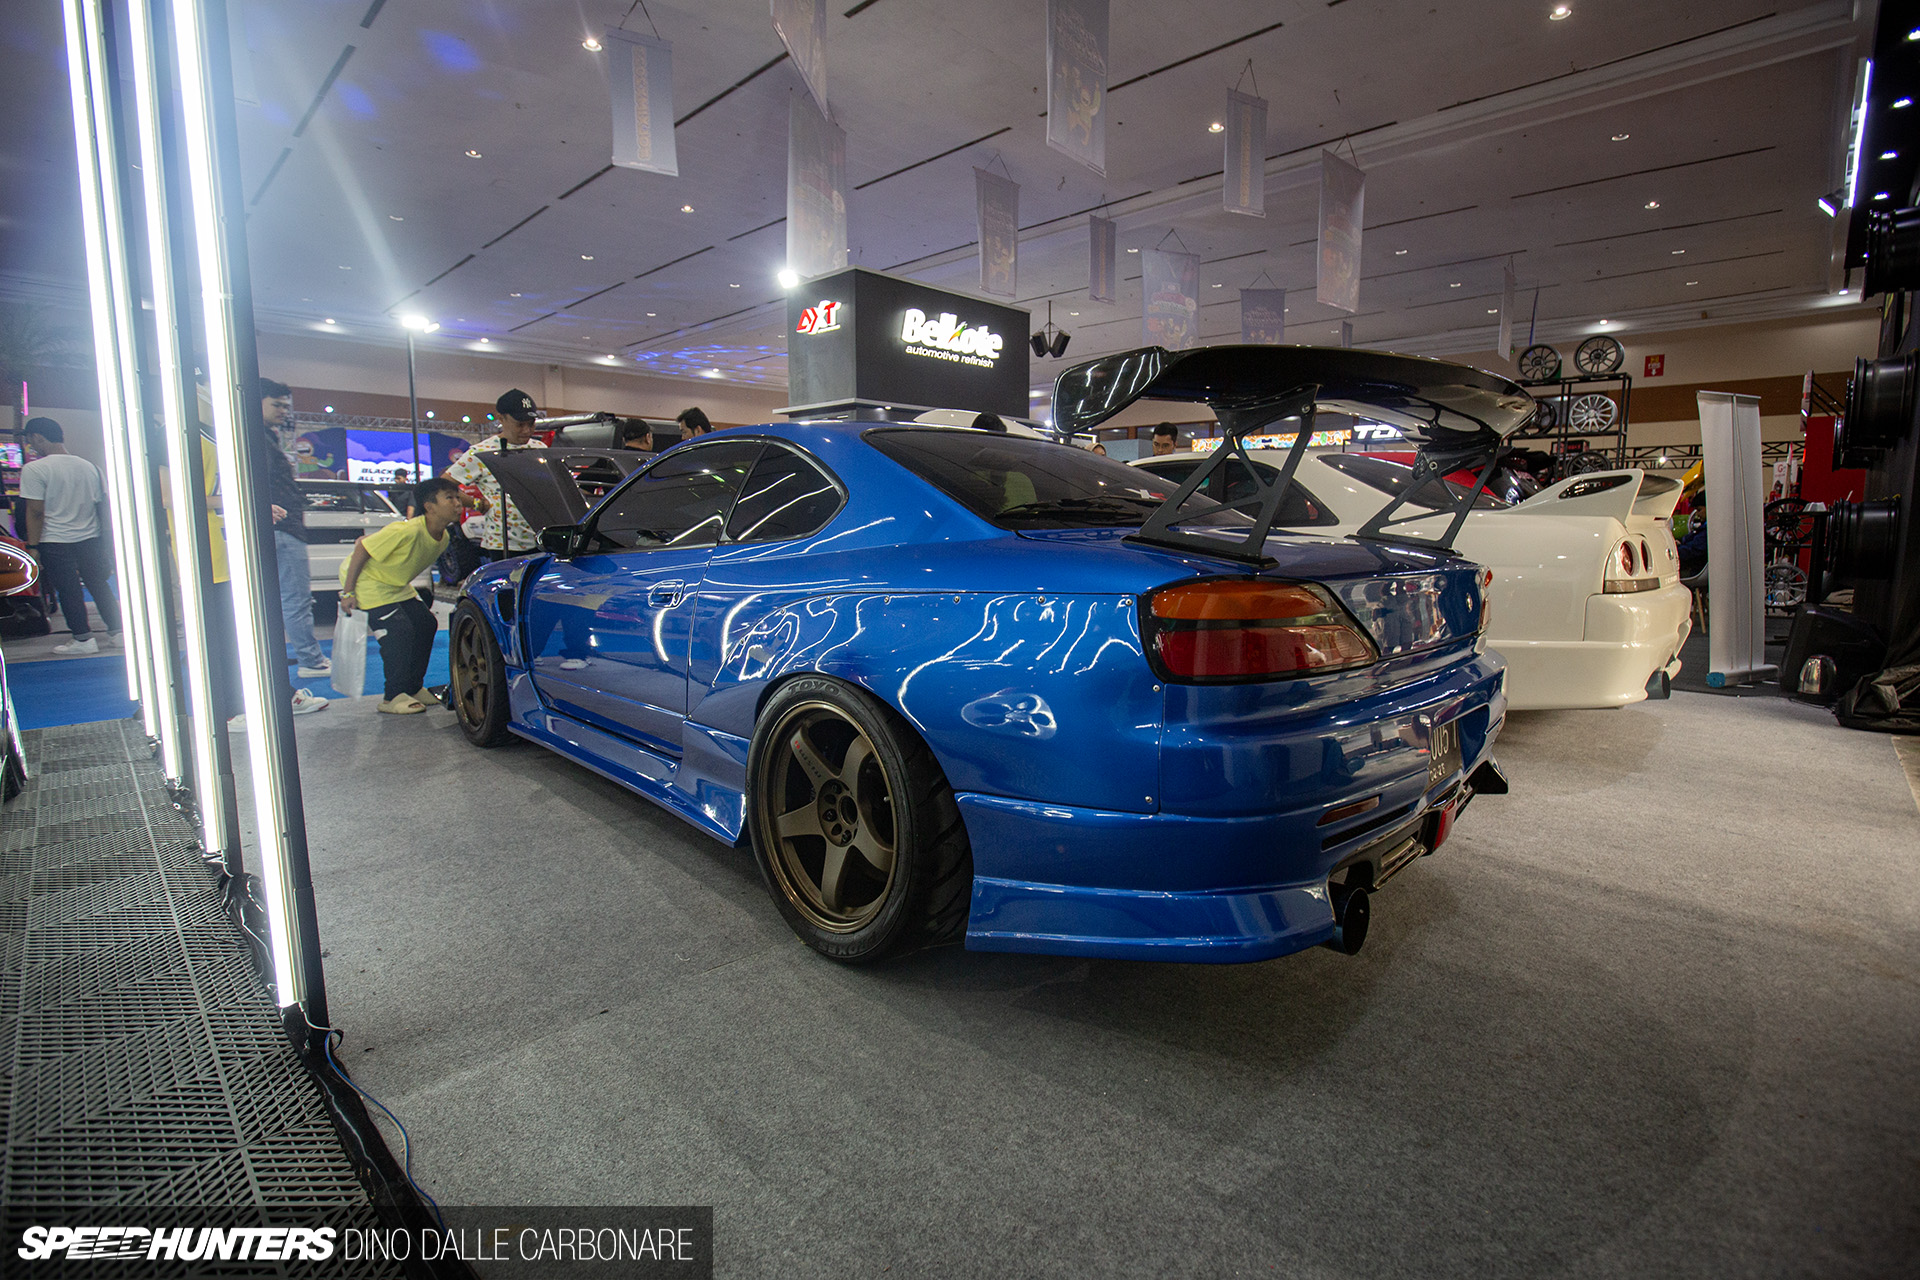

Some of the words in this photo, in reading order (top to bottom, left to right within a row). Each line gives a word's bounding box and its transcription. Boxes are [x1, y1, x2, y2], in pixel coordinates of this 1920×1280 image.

[905, 344, 960, 363] automotive
[961, 354, 994, 368] refinish
[788, 680, 841, 697] TOYO
